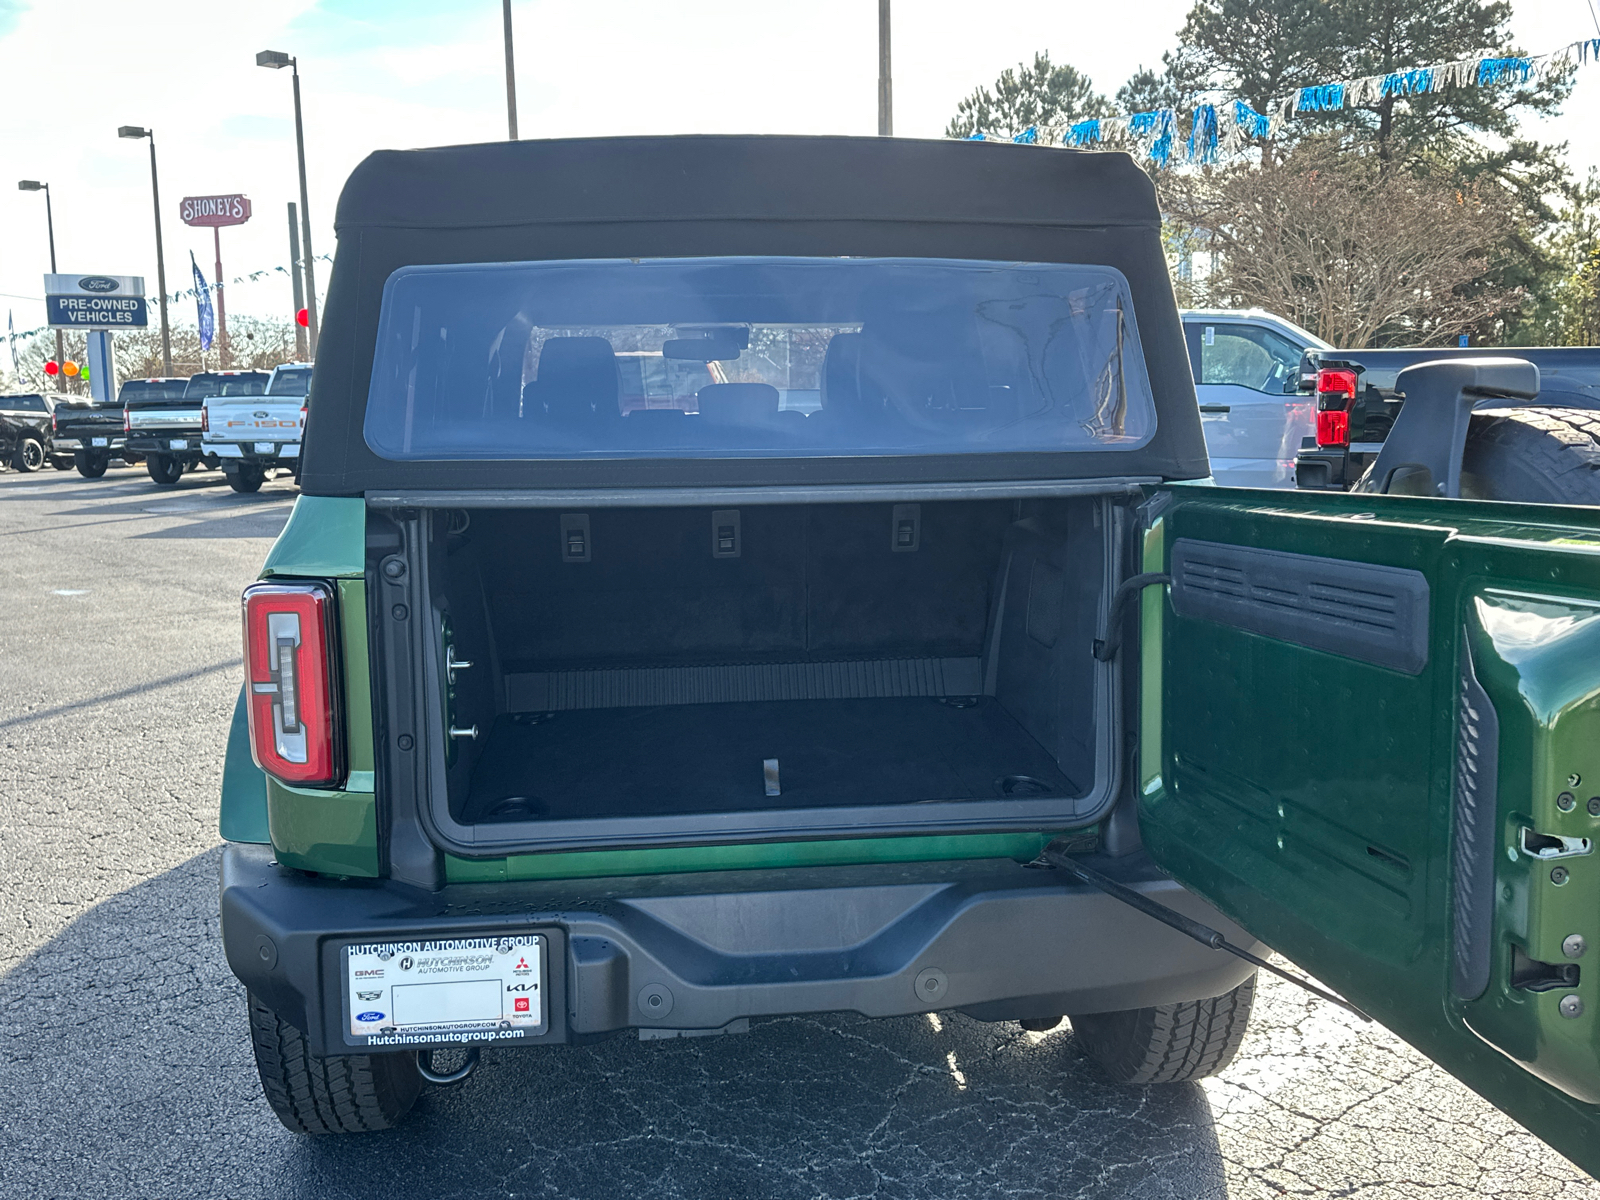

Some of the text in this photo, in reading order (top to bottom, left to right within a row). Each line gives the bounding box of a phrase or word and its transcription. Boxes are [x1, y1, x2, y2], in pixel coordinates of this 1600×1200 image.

[183, 196, 244, 221] SHONEY'S
[88, 280, 111, 289] Ford
[59, 299, 138, 310] PRE-OWNED
[68, 311, 133, 322] VEHICLES
[227, 420, 296, 428] F-150
[347, 935, 540, 956] HUTCHINSON AUTOMOTIVE GROUP
[416, 954, 493, 968] HUTCHINSON
[417, 964, 490, 974] AUTOMOTIVE GROUP
[506, 983, 538, 992] KIA
[361, 1012, 380, 1021] Ford
[400, 1021, 497, 1033] HUTCHINSONAUTOGROUP.COM
[367, 1029, 525, 1046] Hutchinsonautogroup.com
